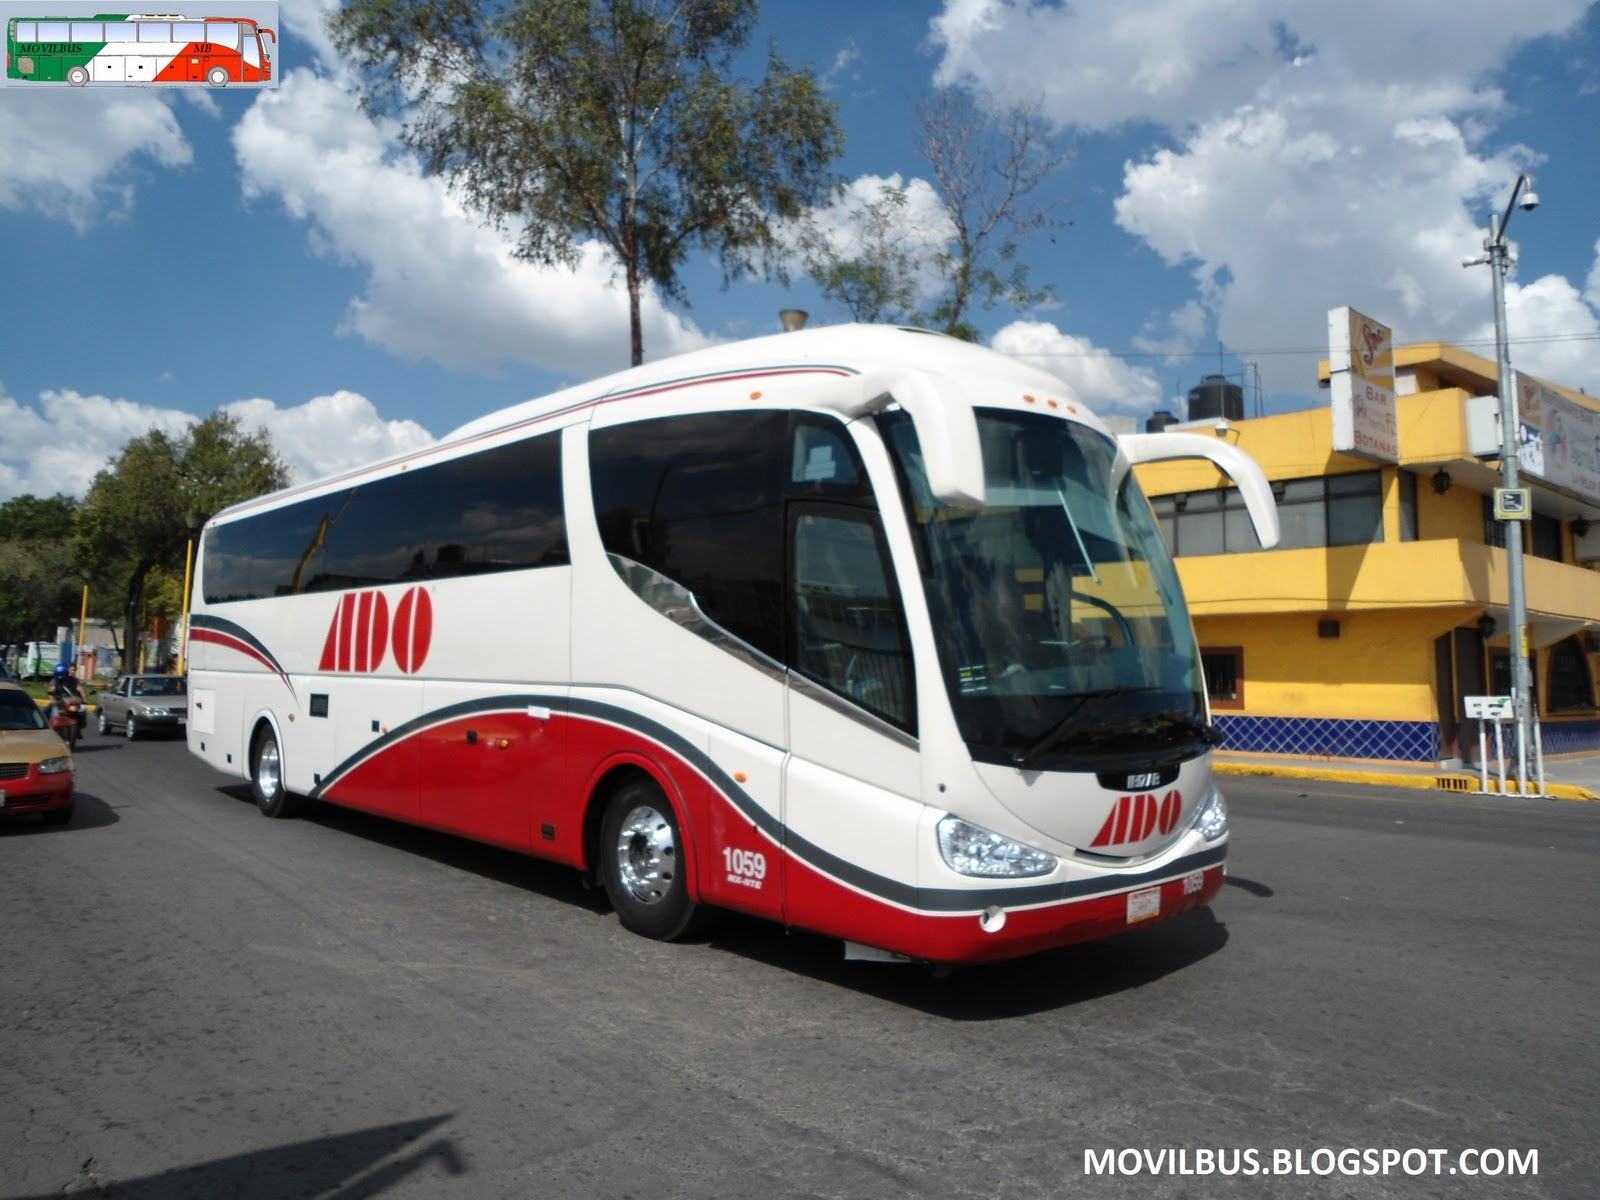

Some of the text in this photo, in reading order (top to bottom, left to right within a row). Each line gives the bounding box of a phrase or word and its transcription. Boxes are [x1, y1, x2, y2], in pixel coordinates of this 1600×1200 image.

[1366, 385, 1387, 406] BAR
[1354, 430, 1398, 456] BOTANAS
[318, 586, 433, 674] ADO
[1089, 789, 1182, 847] ADO
[723, 847, 766, 879] 1059
